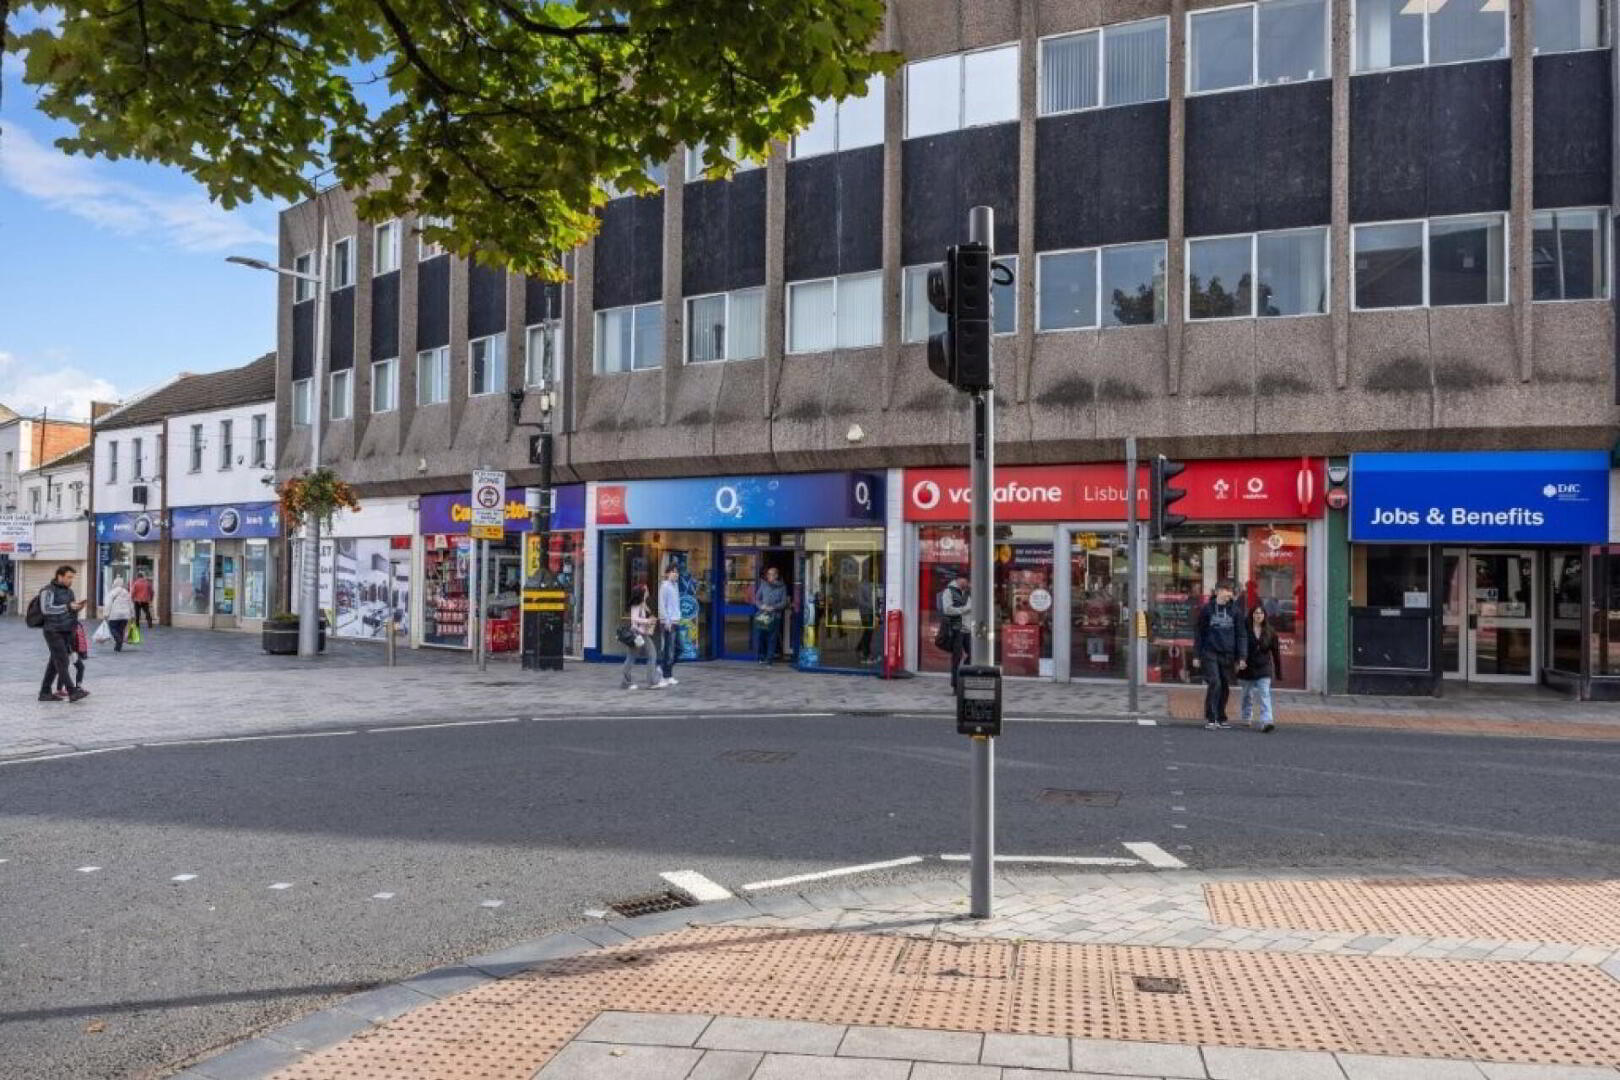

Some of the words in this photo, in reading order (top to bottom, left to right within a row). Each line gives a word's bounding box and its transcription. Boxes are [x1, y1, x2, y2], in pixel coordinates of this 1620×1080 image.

[948, 481, 1062, 503] voafone
[1083, 484, 1149, 501] Lisbun
[1370, 507, 1420, 525] Jobs
[1426, 507, 1446, 525] &
[1451, 507, 1545, 525] Benefits
